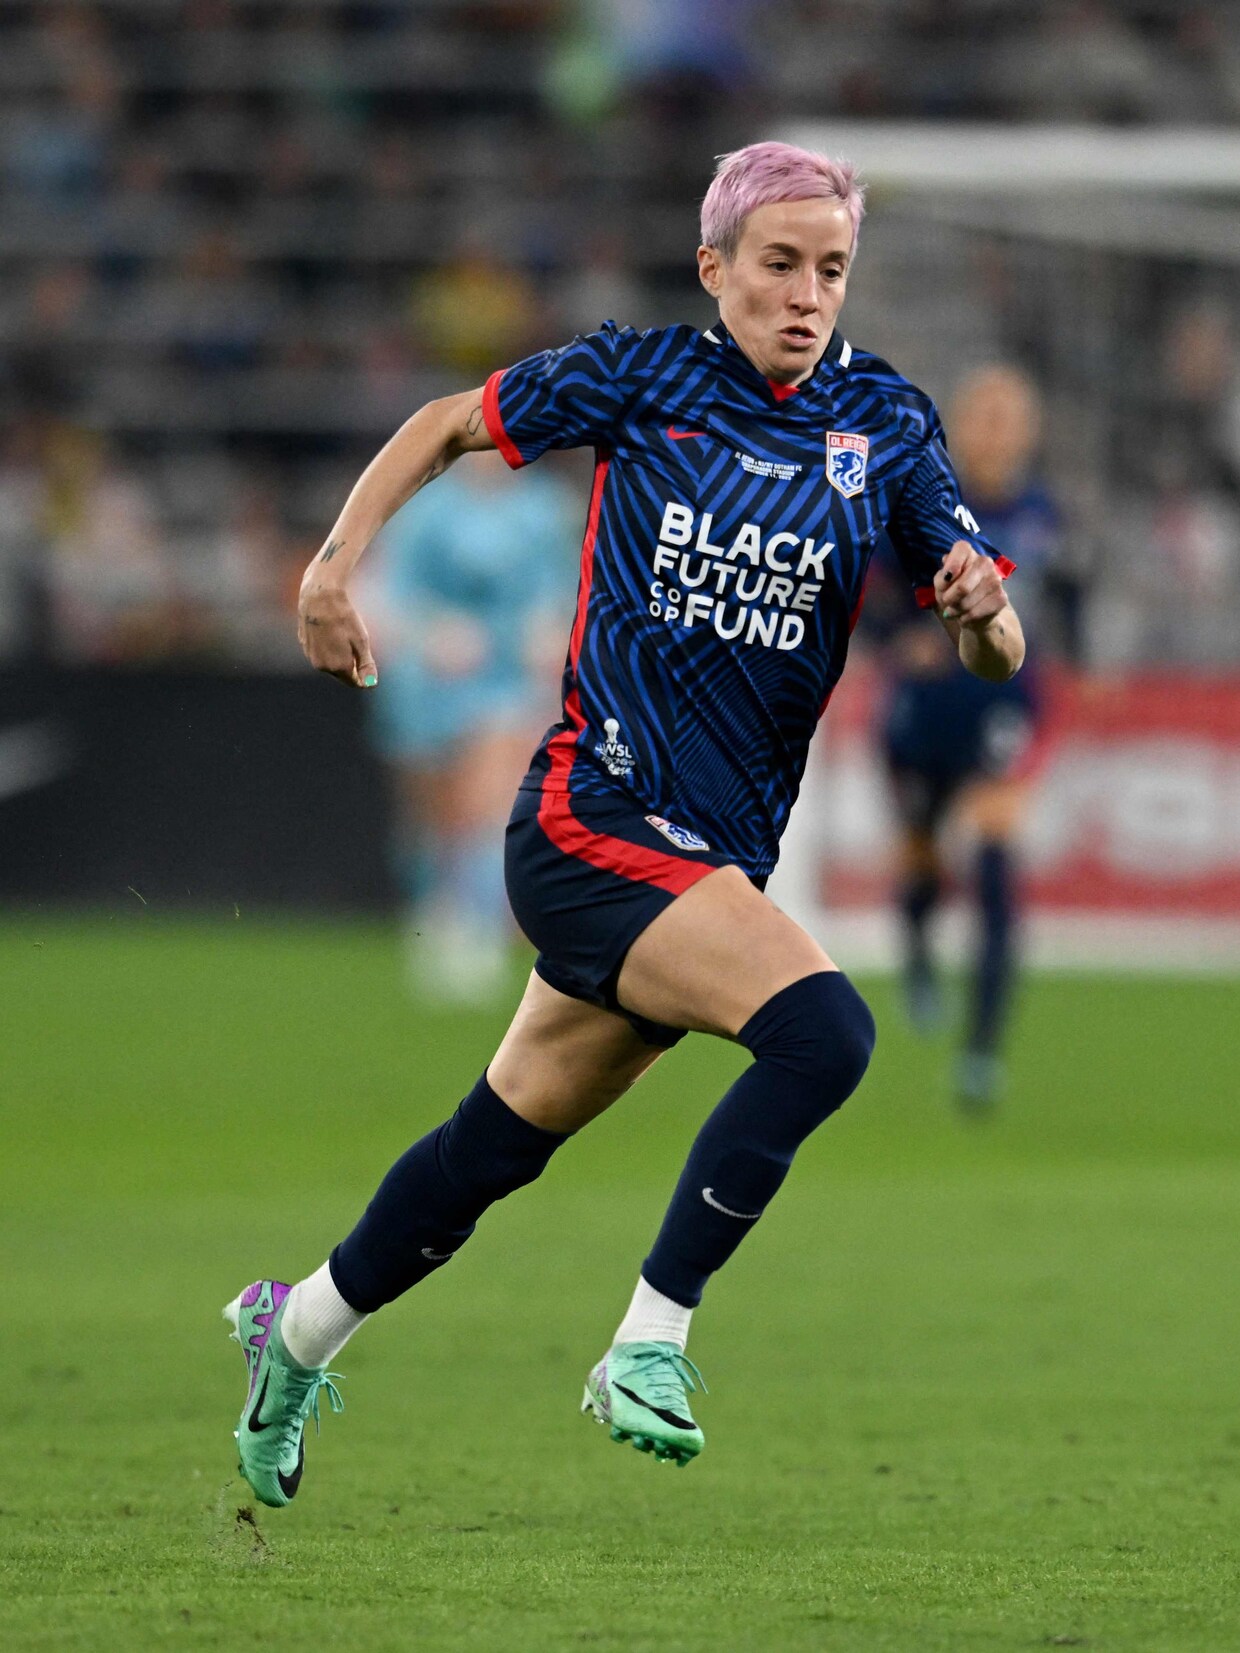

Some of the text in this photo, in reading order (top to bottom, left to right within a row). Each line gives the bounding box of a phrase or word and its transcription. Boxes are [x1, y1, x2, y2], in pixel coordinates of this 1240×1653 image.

[659, 502, 836, 580] BLACK
[650, 581, 681, 603] CO
[653, 544, 822, 612] FUTURE
[649, 601, 679, 621] OP
[684, 593, 805, 650] FUND
